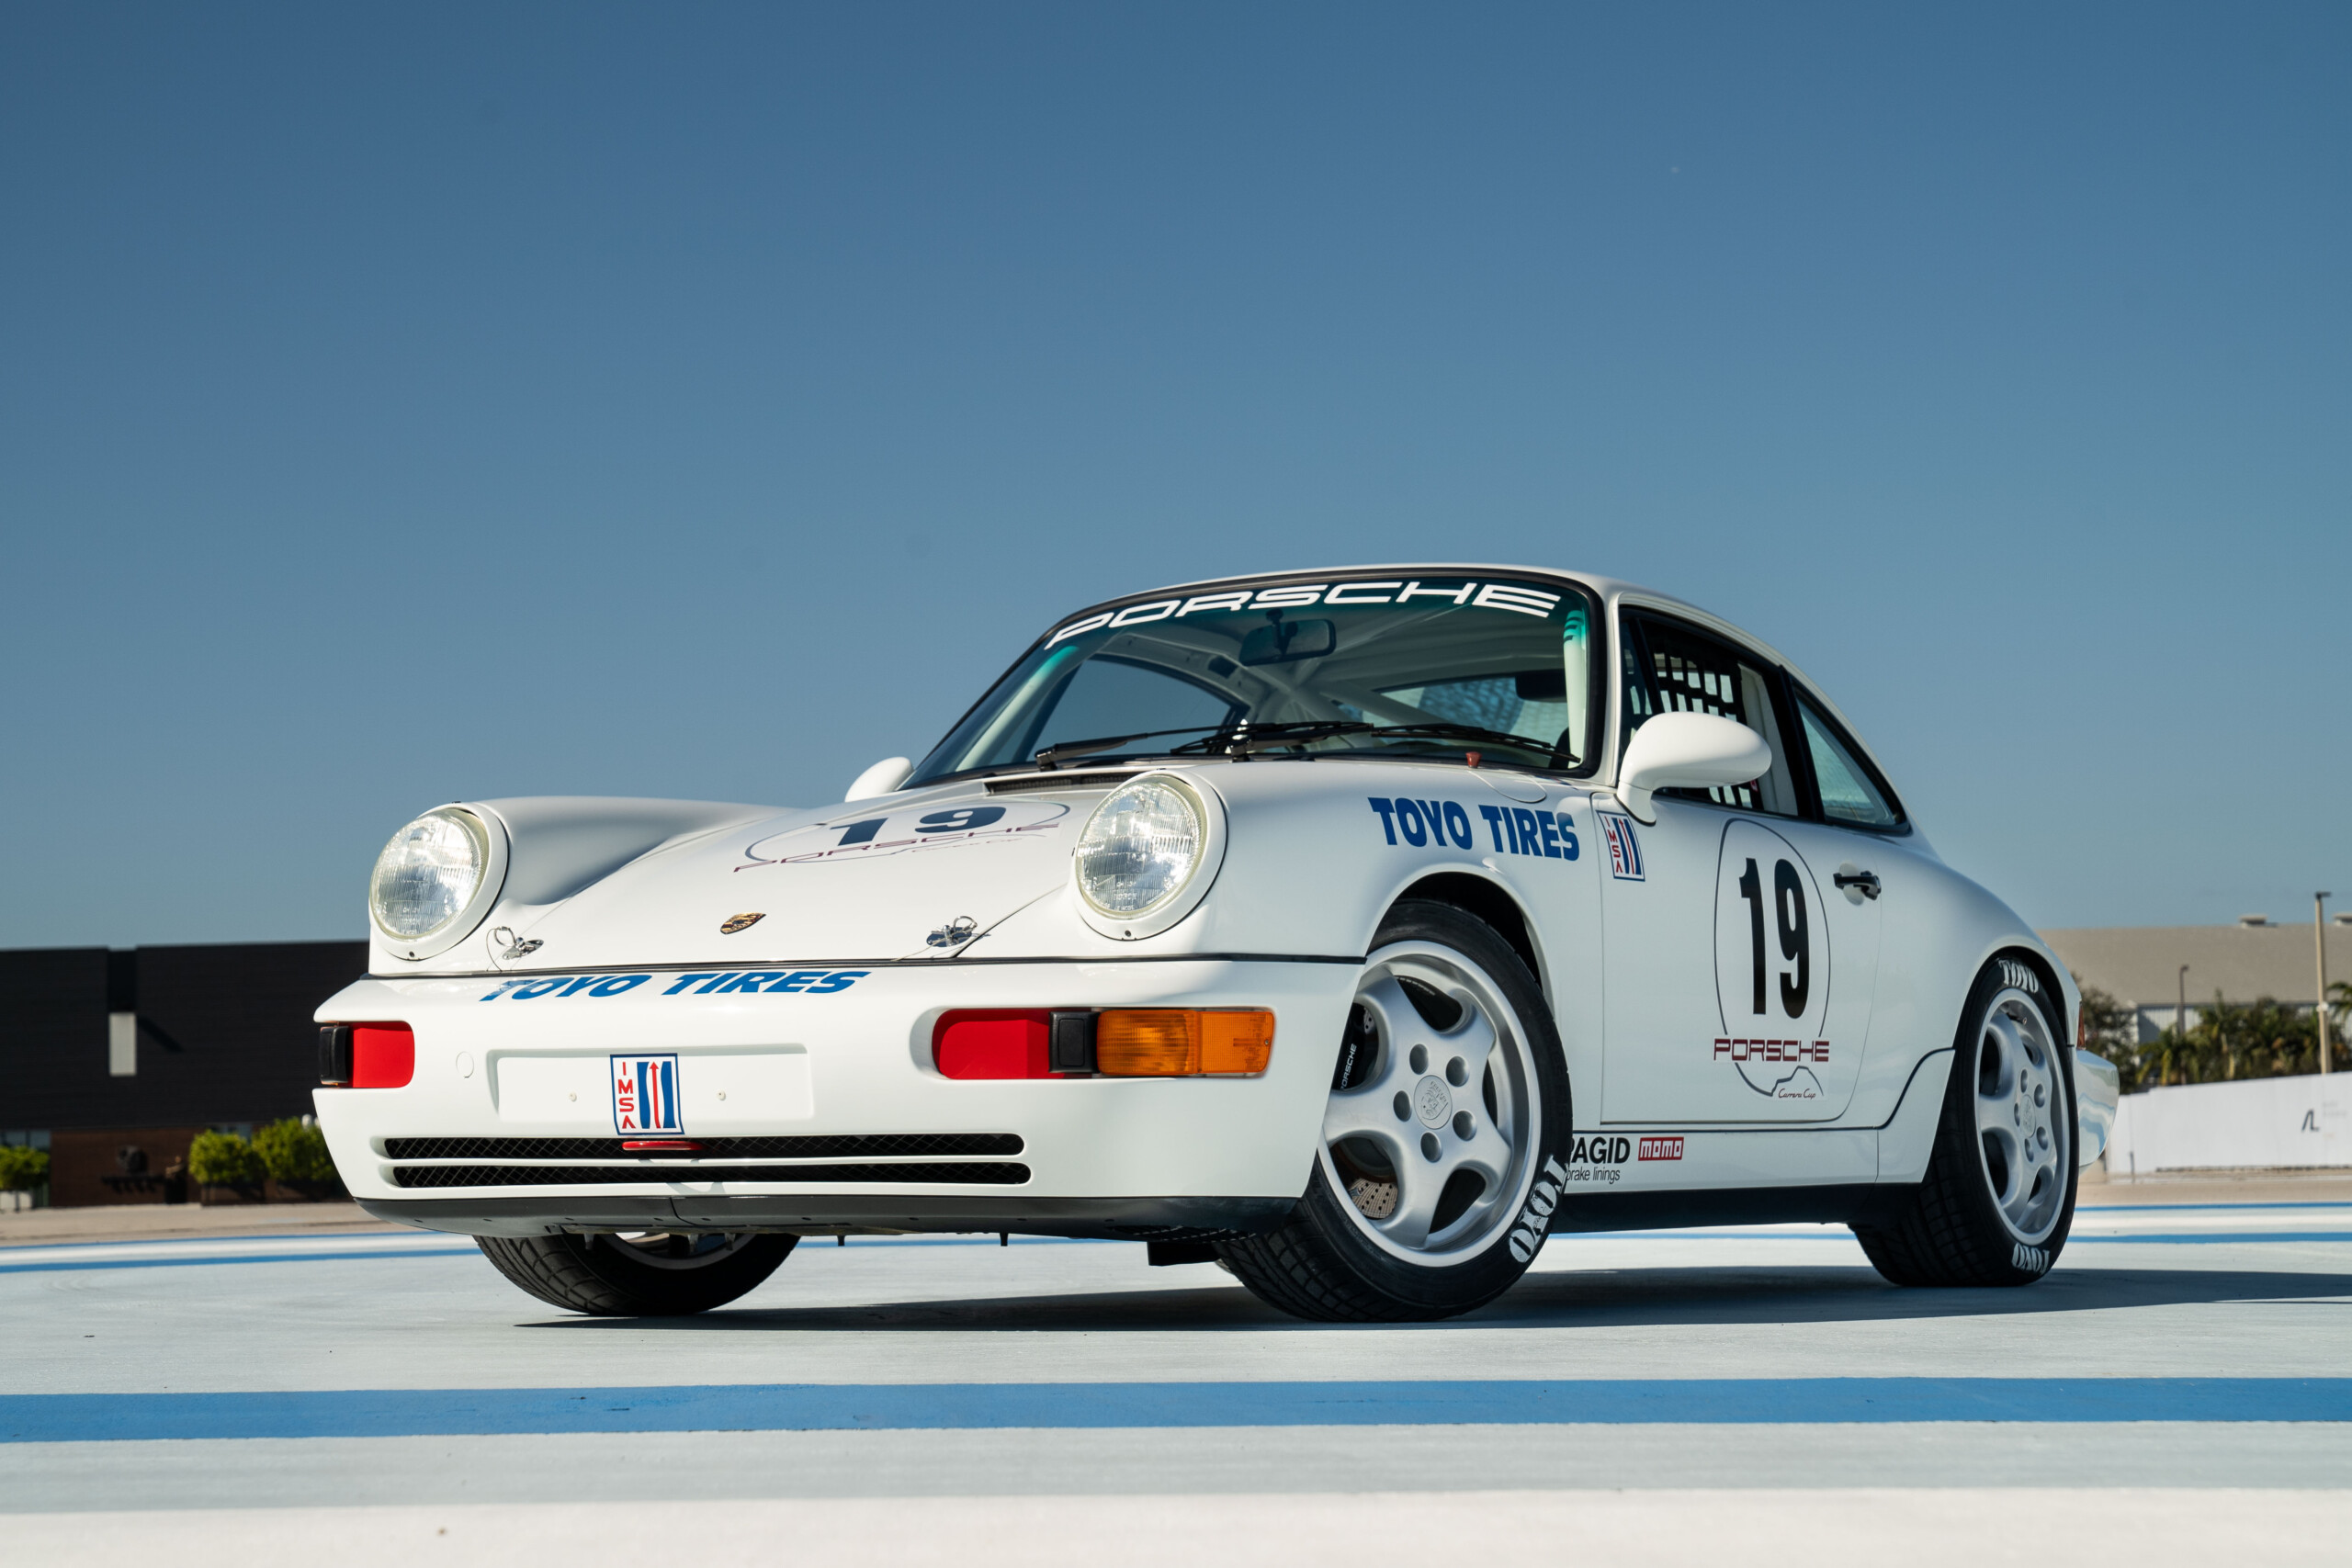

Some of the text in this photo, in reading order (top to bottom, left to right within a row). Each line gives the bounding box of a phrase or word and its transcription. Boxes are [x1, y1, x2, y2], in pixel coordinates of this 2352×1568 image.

[1044, 581, 1561, 650] PORSCHE
[733, 823, 1059, 874] PORSCHE
[829, 806, 1007, 847] 19
[1367, 796, 1580, 862] TOYO TIRES
[1603, 815, 1623, 874] IMSA
[1738, 856, 1810, 1020] 19
[479, 970, 872, 1002] TOYO TIRES
[1997, 959, 2040, 994] TOYO
[1713, 1038, 1830, 1063] PORSCHE
[617, 1061, 637, 1130] IMSA
[1778, 1088, 1816, 1100] Carrera Cup
[1571, 1136, 1631, 1165] AGID
[1592, 1166, 1621, 1185] linings
[1509, 1155, 1569, 1263] TOYO
